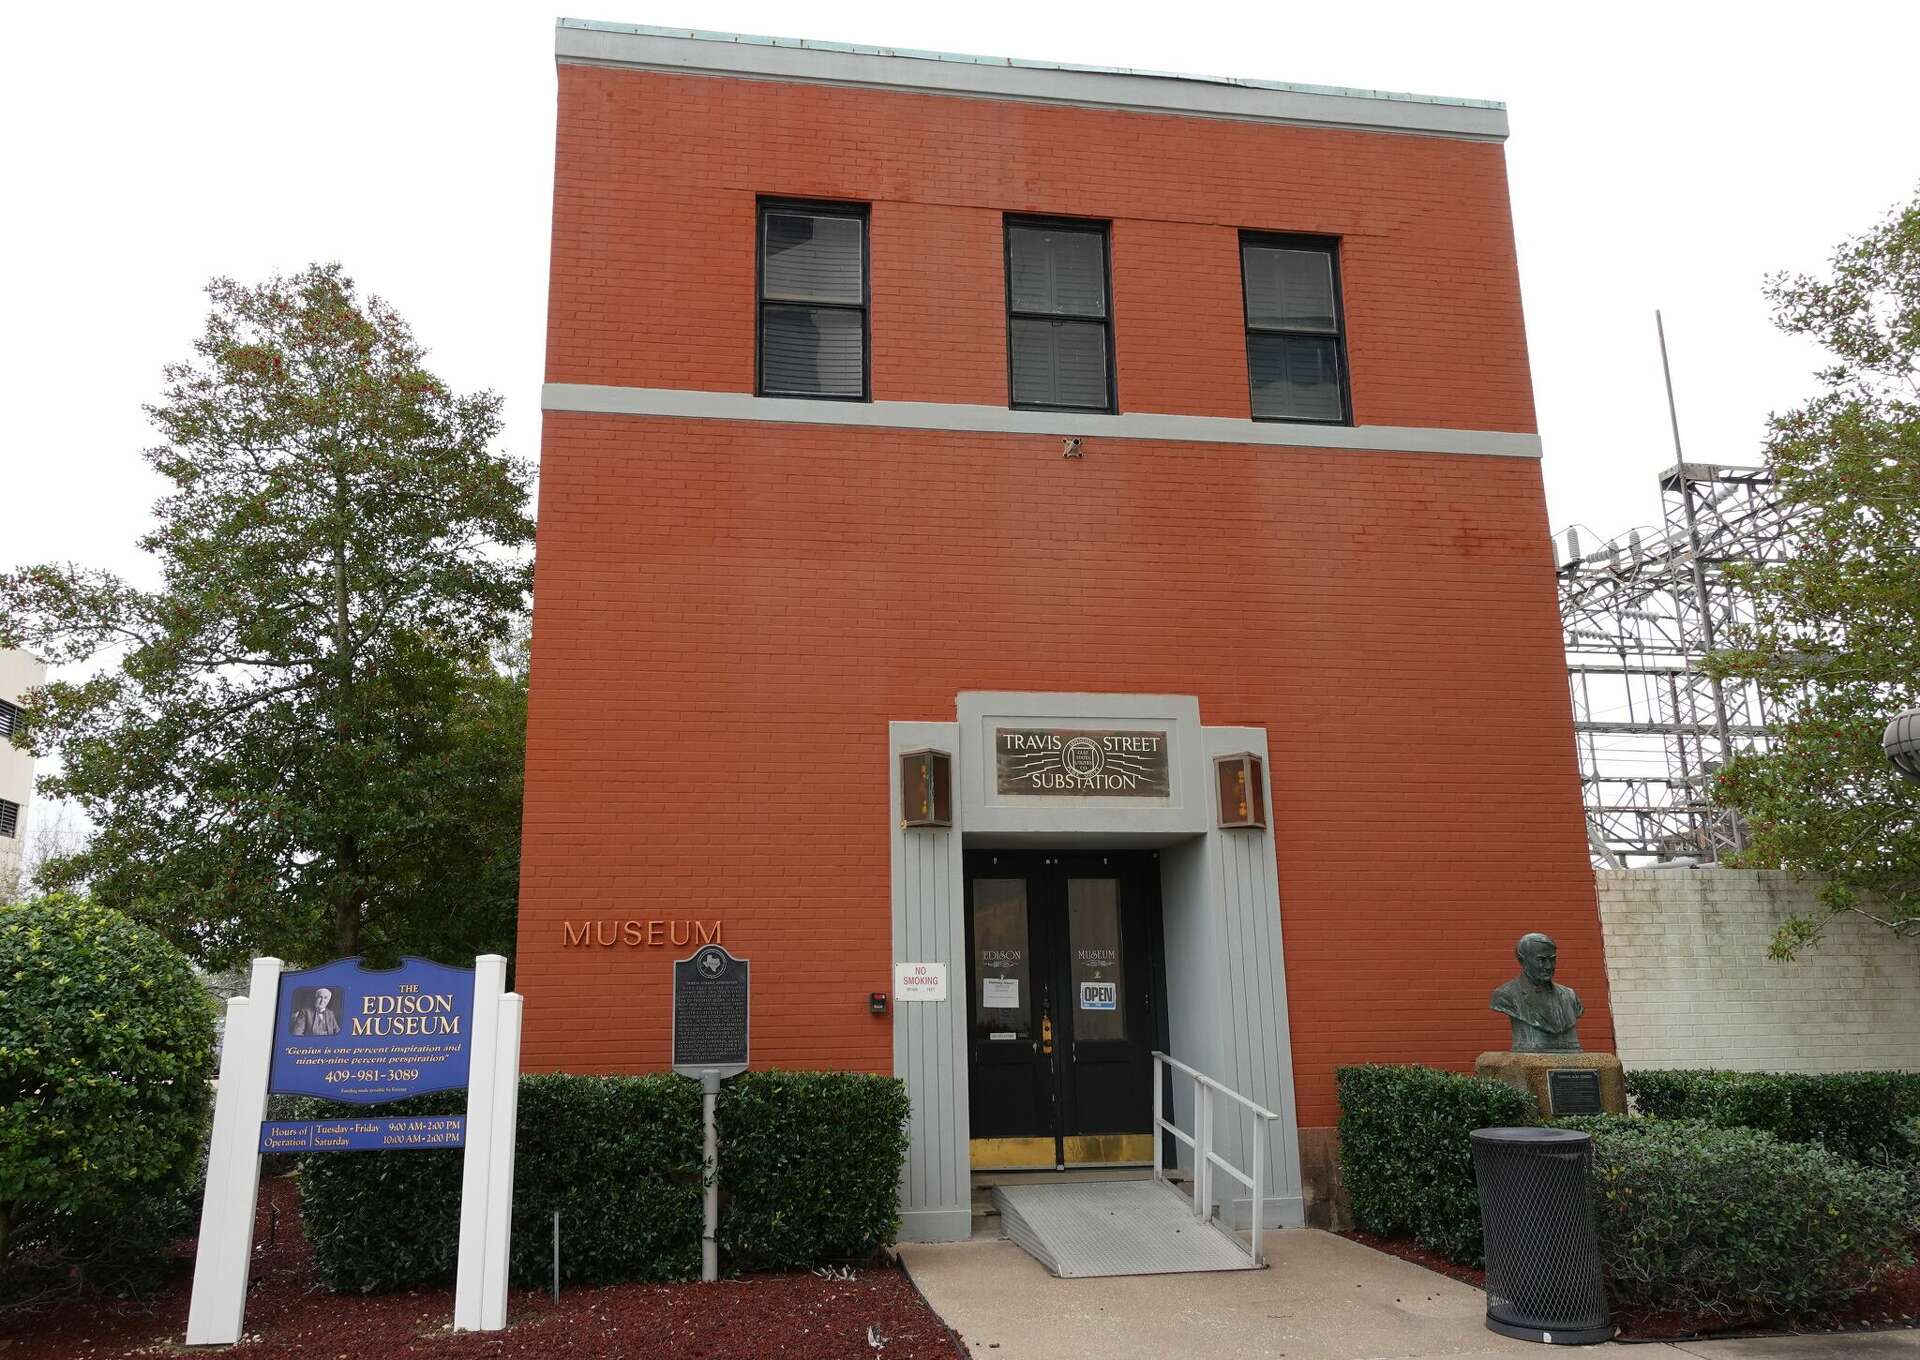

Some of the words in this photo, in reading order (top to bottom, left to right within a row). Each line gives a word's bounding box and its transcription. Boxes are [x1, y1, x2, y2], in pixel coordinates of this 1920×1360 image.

[1003, 734, 1062, 750] TRAVIS
[1103, 736, 1161, 752] STREET
[1032, 773, 1136, 790] SUBSTATION
[562, 920, 722, 946] MUSEUM
[983, 950, 1021, 960] EDISON
[1078, 950, 1115, 960] MUSEUM
[915, 966, 927, 975] NO
[903, 976, 938, 985] SMOKING
[400, 984, 419, 993] THE
[1084, 986, 1113, 1002] OPEN
[362, 994, 453, 1015] EDISON
[352, 1015, 461, 1036] MUSEUM
[324, 1046, 332, 1054] is
[352, 1047, 389, 1055] percent
[390, 1045, 441, 1053] inspiration
[443, 1043, 461, 1052] and
[325, 1068, 418, 1083] 409-981-3089
[271, 1127, 297, 1136] Hours
[299, 1125, 308, 1135] of
[316, 1124, 349, 1135] Tuesday
[355, 1123, 380, 1133] Friday
[446, 1120, 460, 1129] PM
[264, 1137, 306, 1148] Operation
[314, 1137, 350, 1146] Saturday
[445, 1133, 460, 1142] PM
